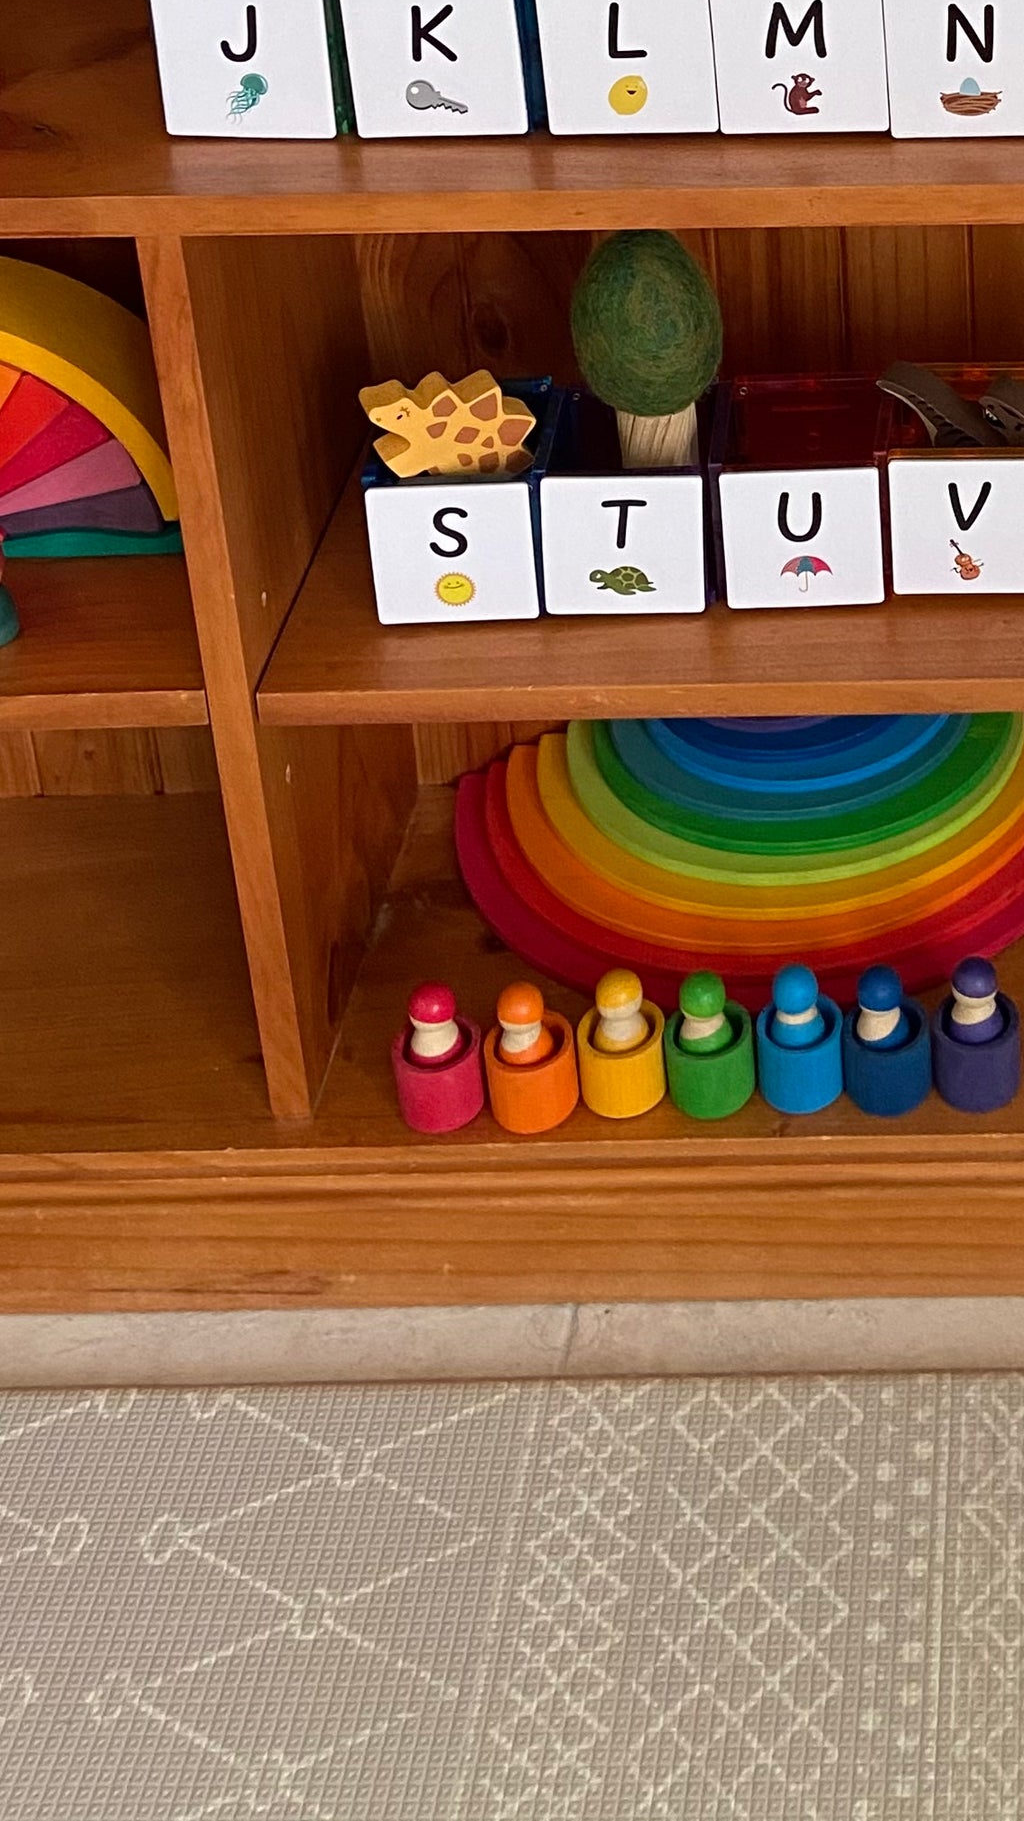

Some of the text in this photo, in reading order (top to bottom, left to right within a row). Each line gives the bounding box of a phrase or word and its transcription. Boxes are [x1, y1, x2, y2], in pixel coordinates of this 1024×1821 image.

[220, 4, 258, 63] J
[410, 4, 458, 62] K
[607, 2, 648, 59] L
[764, 0, 828, 59] M
[946, 3, 995, 64] N
[429, 506, 469, 558] S
[600, 499, 648, 549] T
[777, 491, 823, 543] U
[947, 481, 992, 532] V
